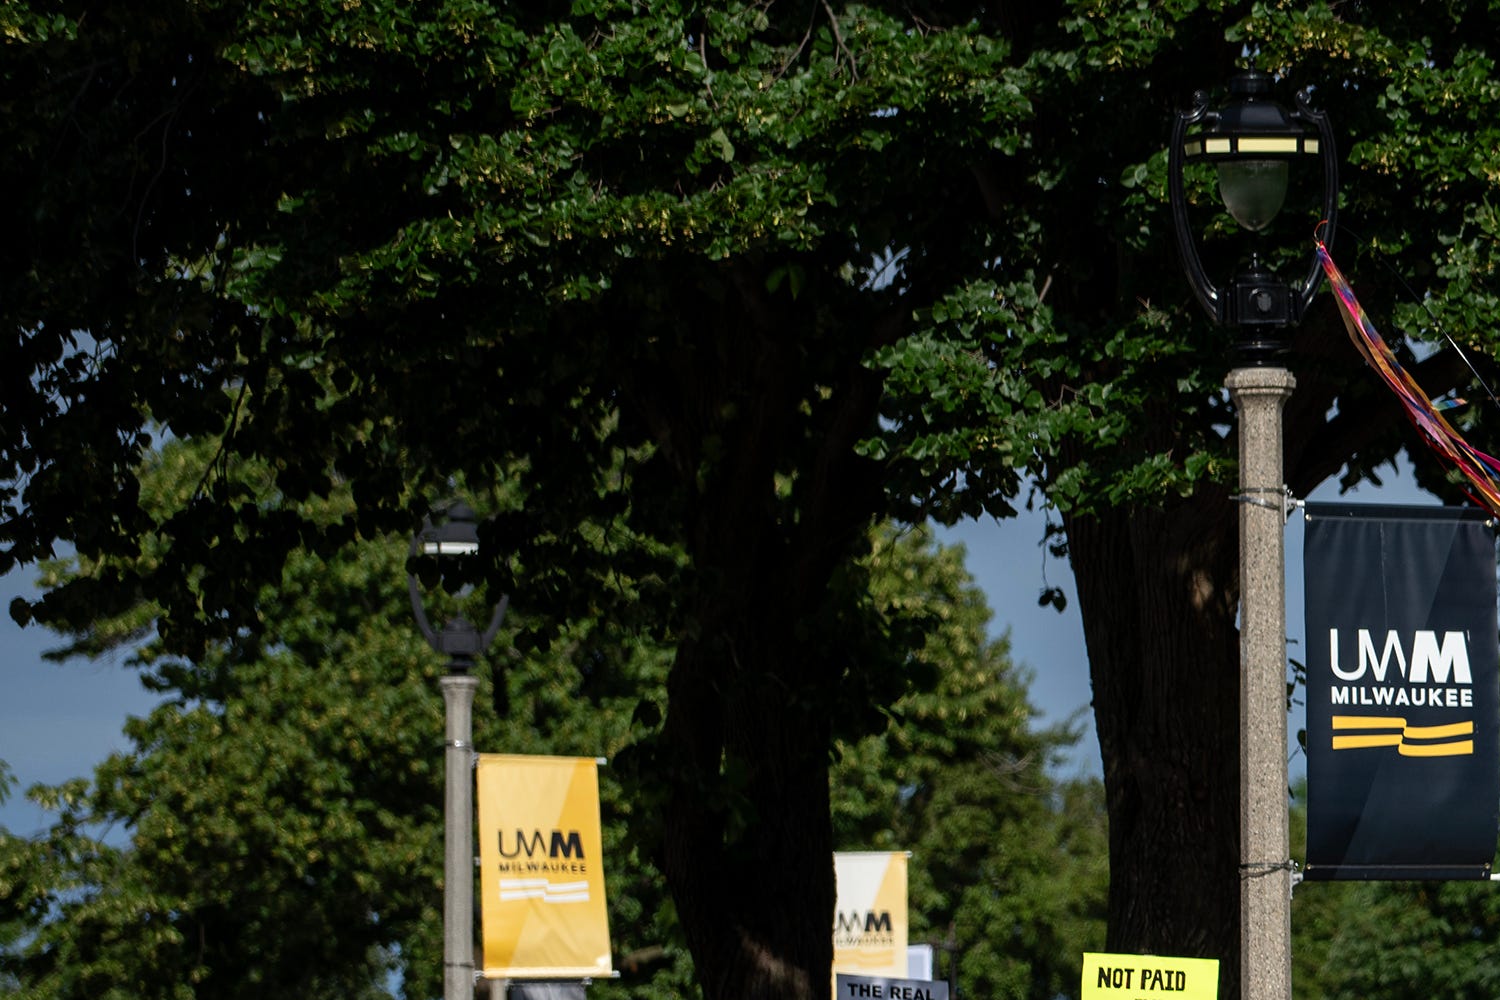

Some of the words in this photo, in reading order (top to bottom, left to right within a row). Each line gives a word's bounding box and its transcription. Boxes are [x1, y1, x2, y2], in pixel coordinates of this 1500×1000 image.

[1330, 628, 1472, 683] UWM
[1331, 686, 1473, 707] MILWAUKEE
[497, 829, 583, 859] UWM
[498, 863, 587, 874] MILWAUKEE
[1097, 967, 1134, 989] NOT
[1140, 969, 1186, 991] PAID
[848, 983, 882, 998] THE
